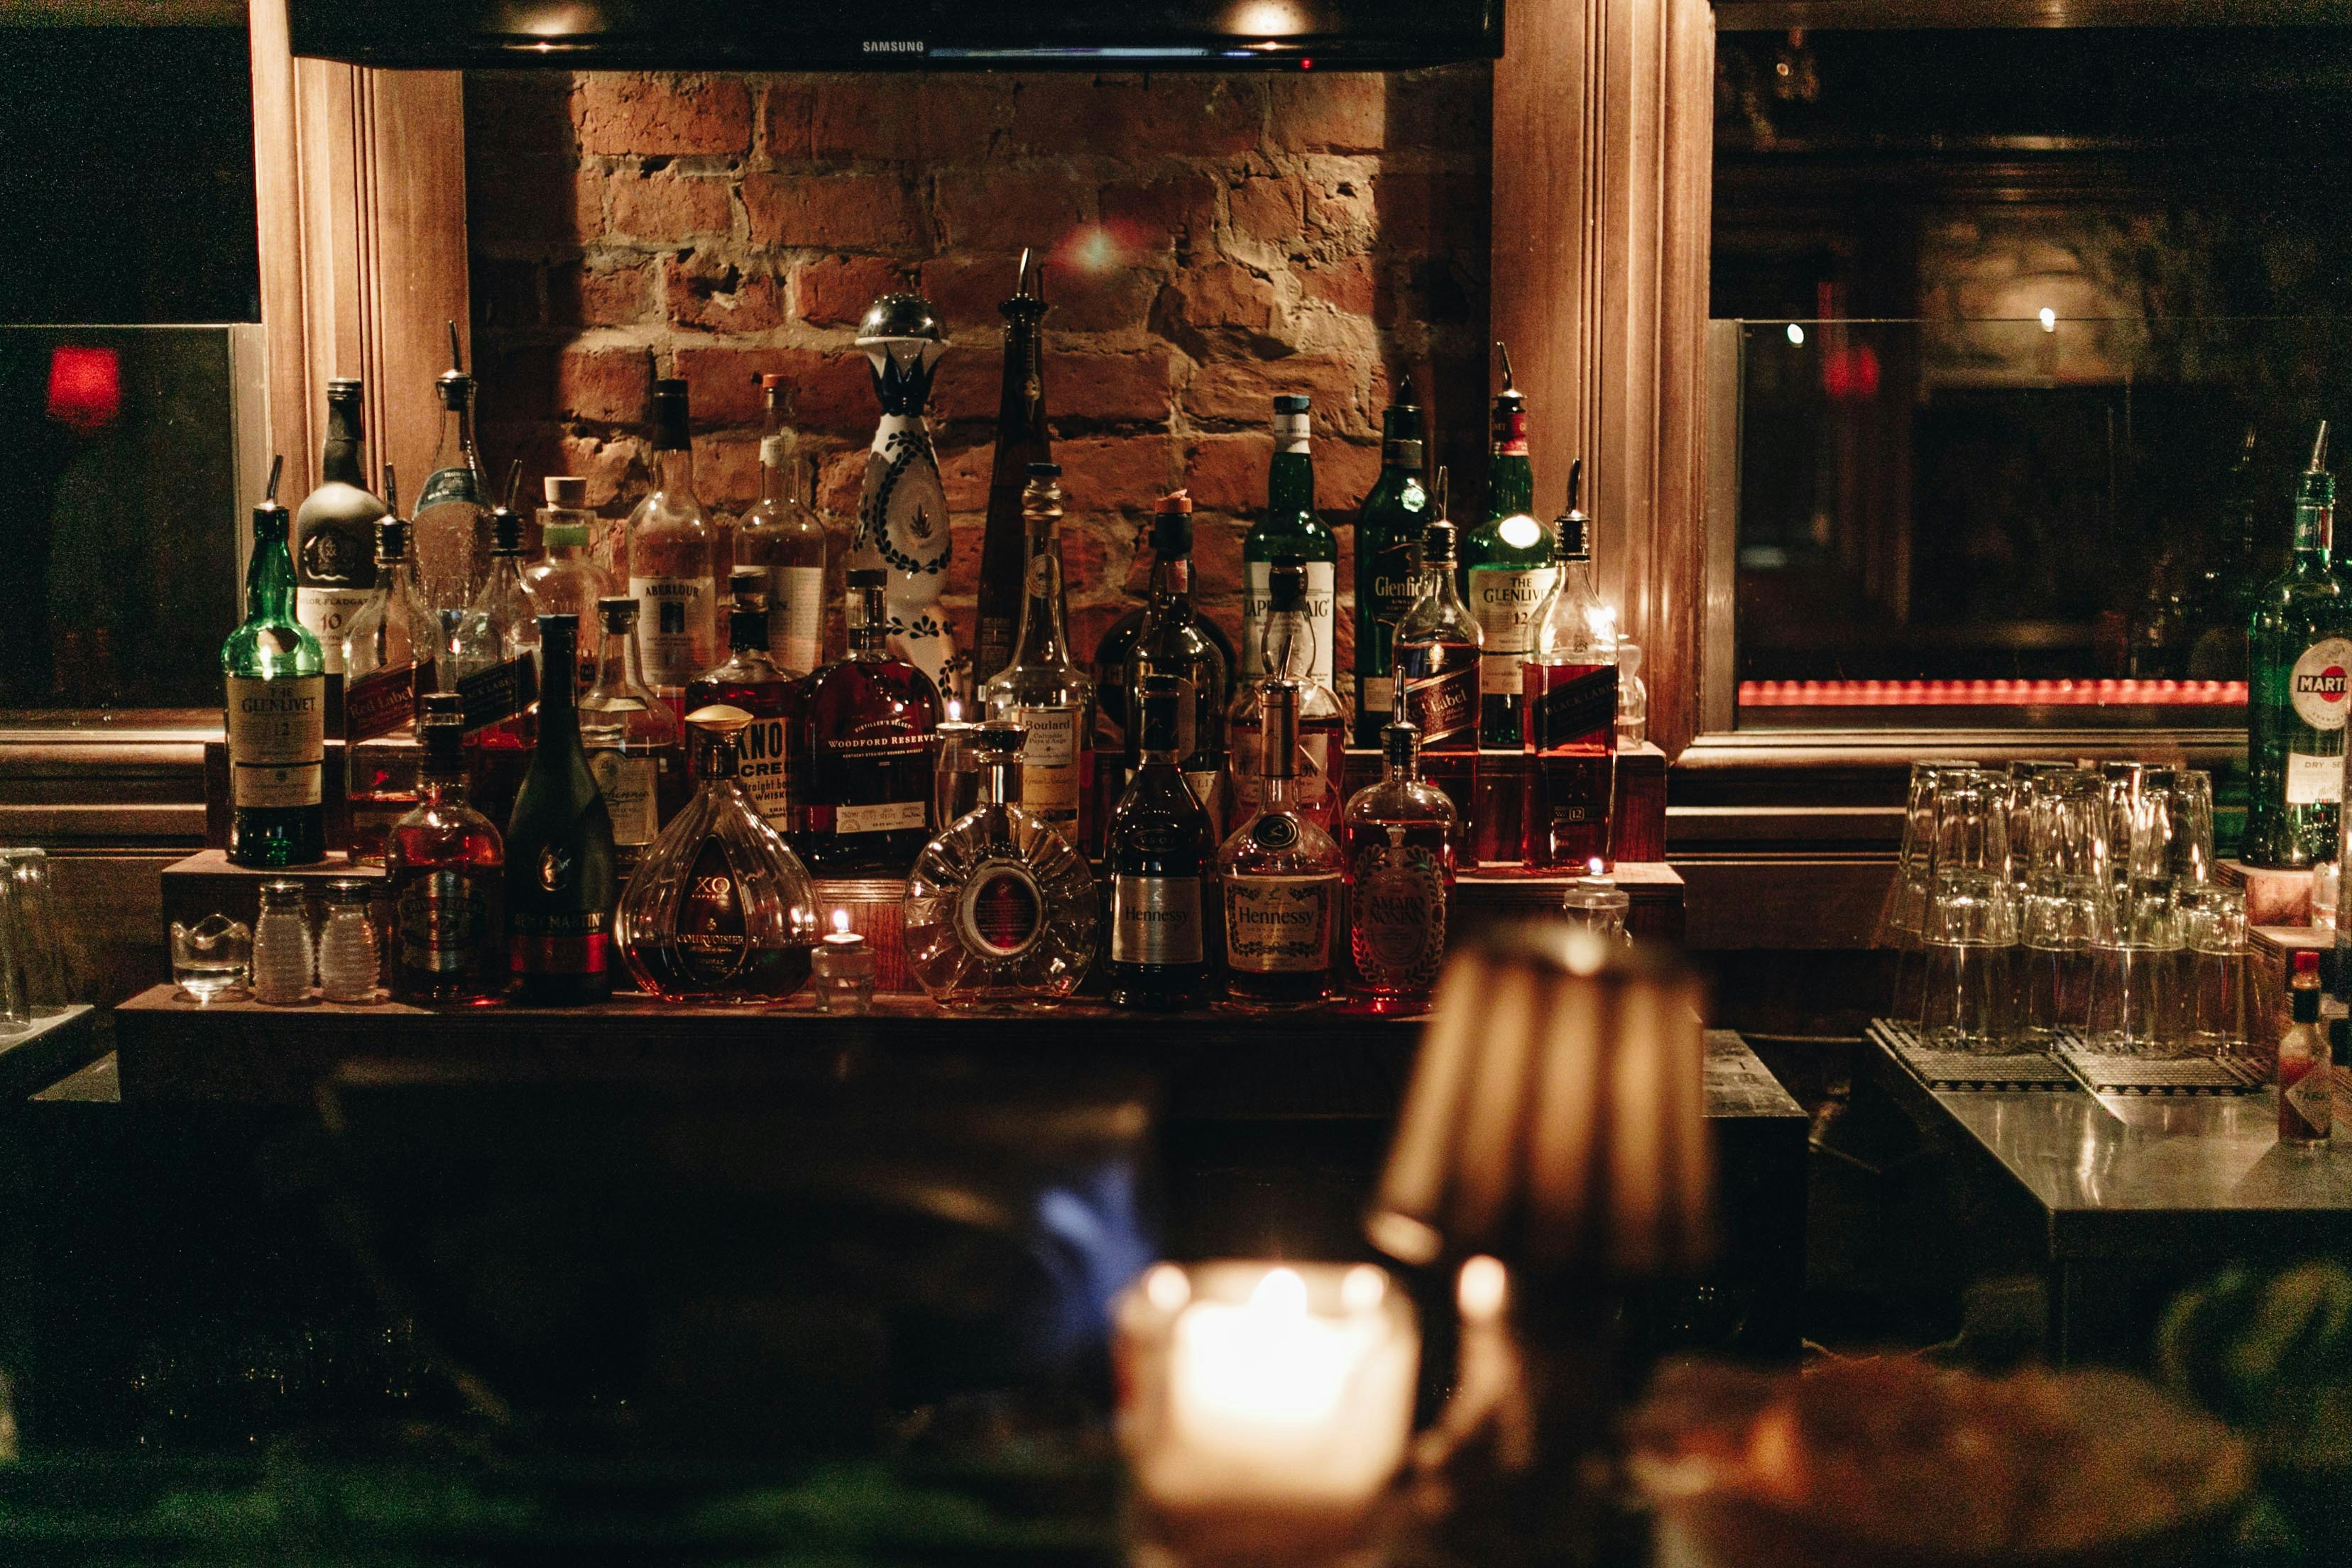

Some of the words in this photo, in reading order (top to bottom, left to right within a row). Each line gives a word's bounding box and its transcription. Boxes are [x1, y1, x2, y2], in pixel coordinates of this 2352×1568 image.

[863, 41, 924, 52] SAMSUNG
[1511, 578, 1532, 588] THE
[645, 584, 699, 597] ABERLOUR
[321, 613, 342, 631] 10
[1514, 613, 1528, 625] 12
[268, 687, 295, 697] THE
[378, 686, 413, 710] Label
[241, 696, 316, 713] GLENLIVET
[1430, 689, 1467, 713] Label
[1545, 696, 1581, 716] BLACK
[1026, 720, 1070, 730] Boulard
[828, 738, 888, 748] WOODFORD
[1572, 809, 1582, 818] 12
[696, 877, 731, 894] XO
[1372, 897, 1425, 909] AMARO
[1125, 906, 1188, 923] Hennessy
[1239, 906, 1313, 926] Hennessy
[677, 934, 745, 947] COURVOISIER
